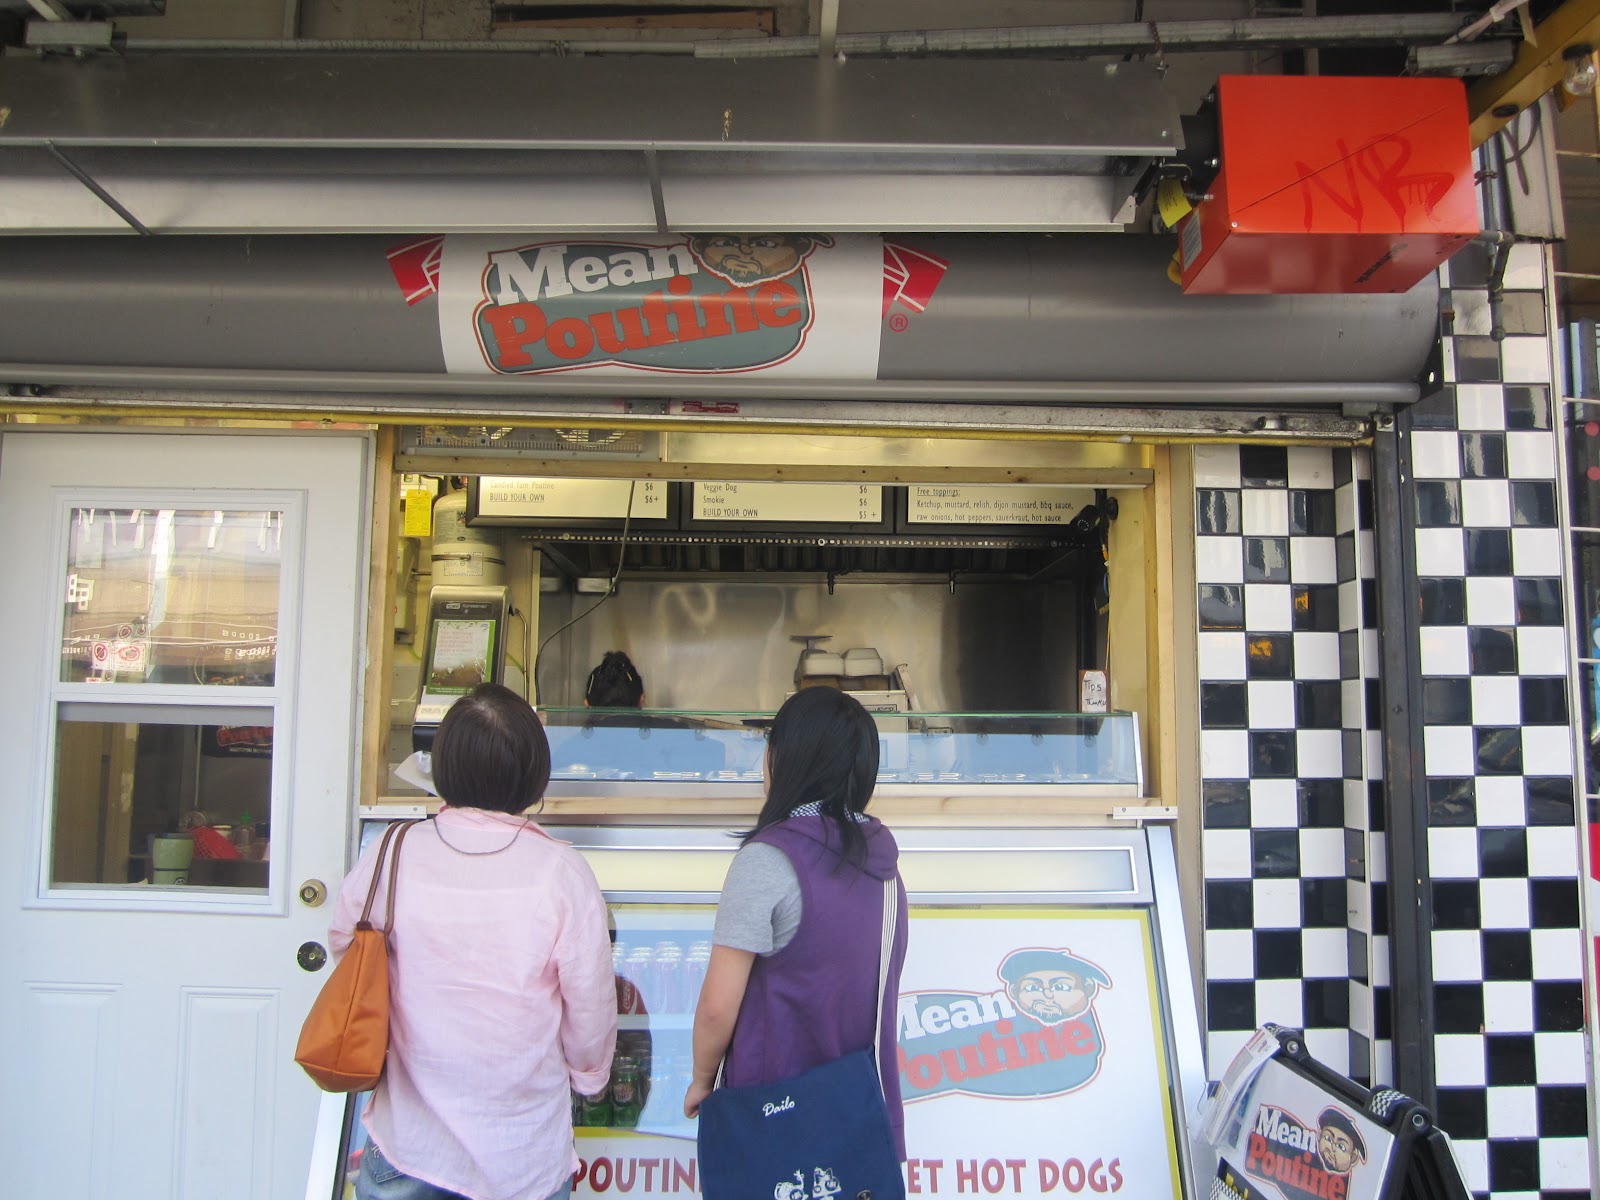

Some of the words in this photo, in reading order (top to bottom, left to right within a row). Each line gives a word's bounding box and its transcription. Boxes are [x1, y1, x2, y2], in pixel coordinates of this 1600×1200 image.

[491, 244, 699, 306] Mean
[483, 274, 801, 368] Poutine
[531, 481, 555, 490] Poutine
[644, 482, 654, 491] $6
[703, 482, 722, 493] Veggie
[725, 483, 738, 494] Dog
[859, 485, 868, 494] $6
[932, 487, 961, 498] toppings:
[489, 492, 508, 501] BUILD
[510, 493, 527, 502] YOUR
[529, 493, 545, 502] OWN
[703, 495, 725, 504] Smokie
[859, 498, 868, 507] $6
[916, 500, 943, 510] Ketchup,
[944, 500, 972, 509] mustard,
[973, 500, 992, 509] relish,
[993, 500, 1009, 511] dijon
[1011, 500, 1039, 510] mustard,
[1040, 501, 1052, 511] bbq
[703, 507, 722, 517] BUILD
[723, 508, 740, 517] YOUR
[742, 508, 758, 517] OWN
[859, 510, 867, 519] $5
[916, 513, 928, 521] raw
[930, 512, 953, 522] onions,
[954, 513, 966, 521] hot
[967, 514, 994, 523] peppers,
[995, 513, 1030, 522] sauerkraut,
[1031, 513, 1043, 522] hot
[1044, 514, 1062, 522] sauce
[1083, 679, 1102, 693] Tips
[897, 1018, 1097, 1090] outine
[762, 1096, 796, 1117] Dailo
[1255, 1105, 1317, 1153] Mean
[1245, 1131, 1348, 1200] Poutine
[571, 1156, 703, 1193] POUTIN
[956, 1158, 1027, 1193] HOT
[1038, 1157, 1124, 1193] DOGS
